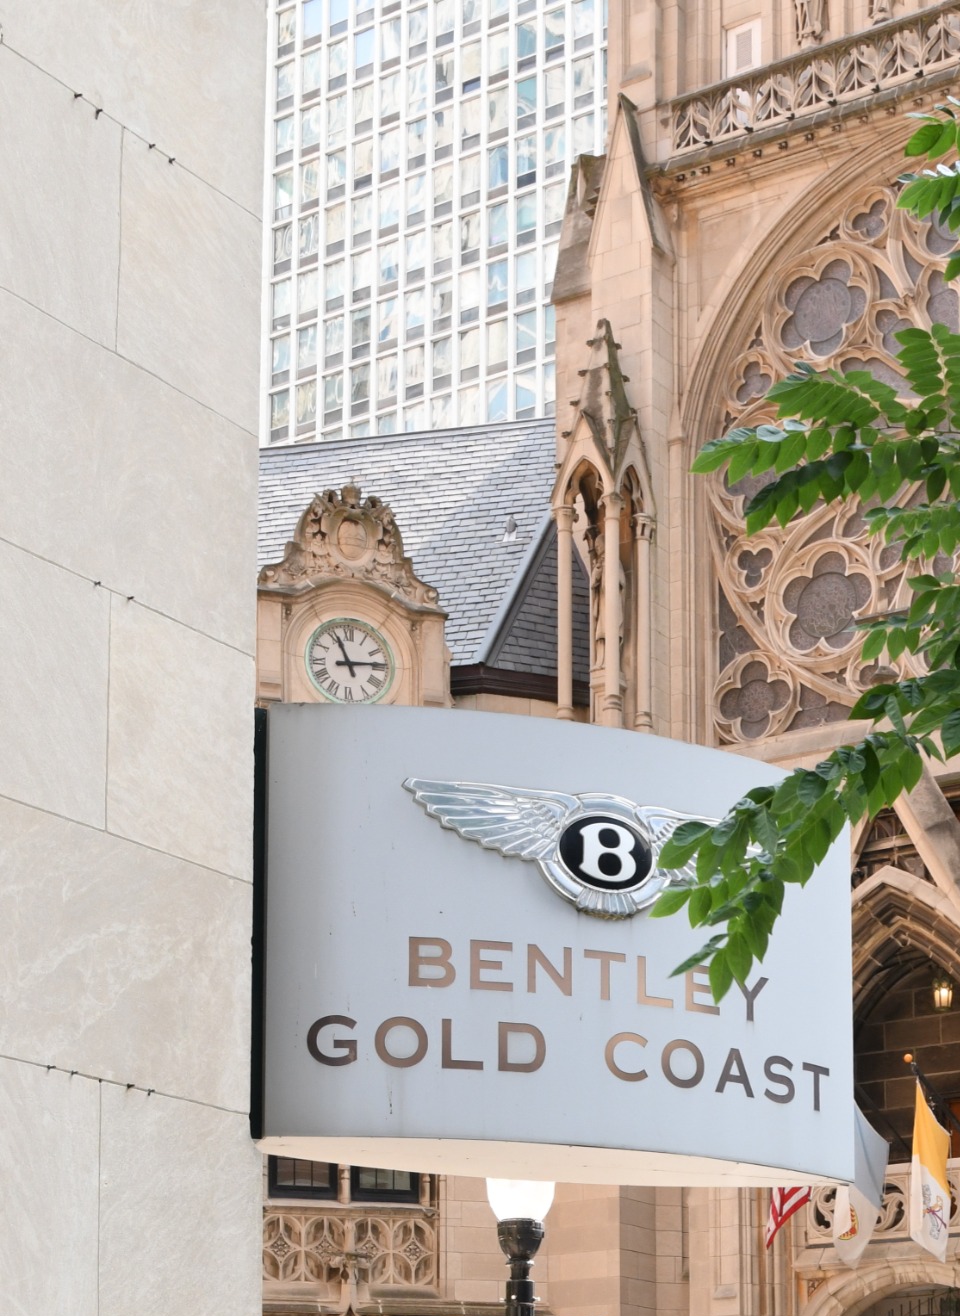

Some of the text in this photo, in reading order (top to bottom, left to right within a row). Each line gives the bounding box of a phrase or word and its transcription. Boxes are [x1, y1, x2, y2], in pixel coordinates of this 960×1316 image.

[578, 822, 639, 883] B
[407, 936, 769, 1022] BENTLEY
[306, 1014, 830, 1112] GOLD COAST
